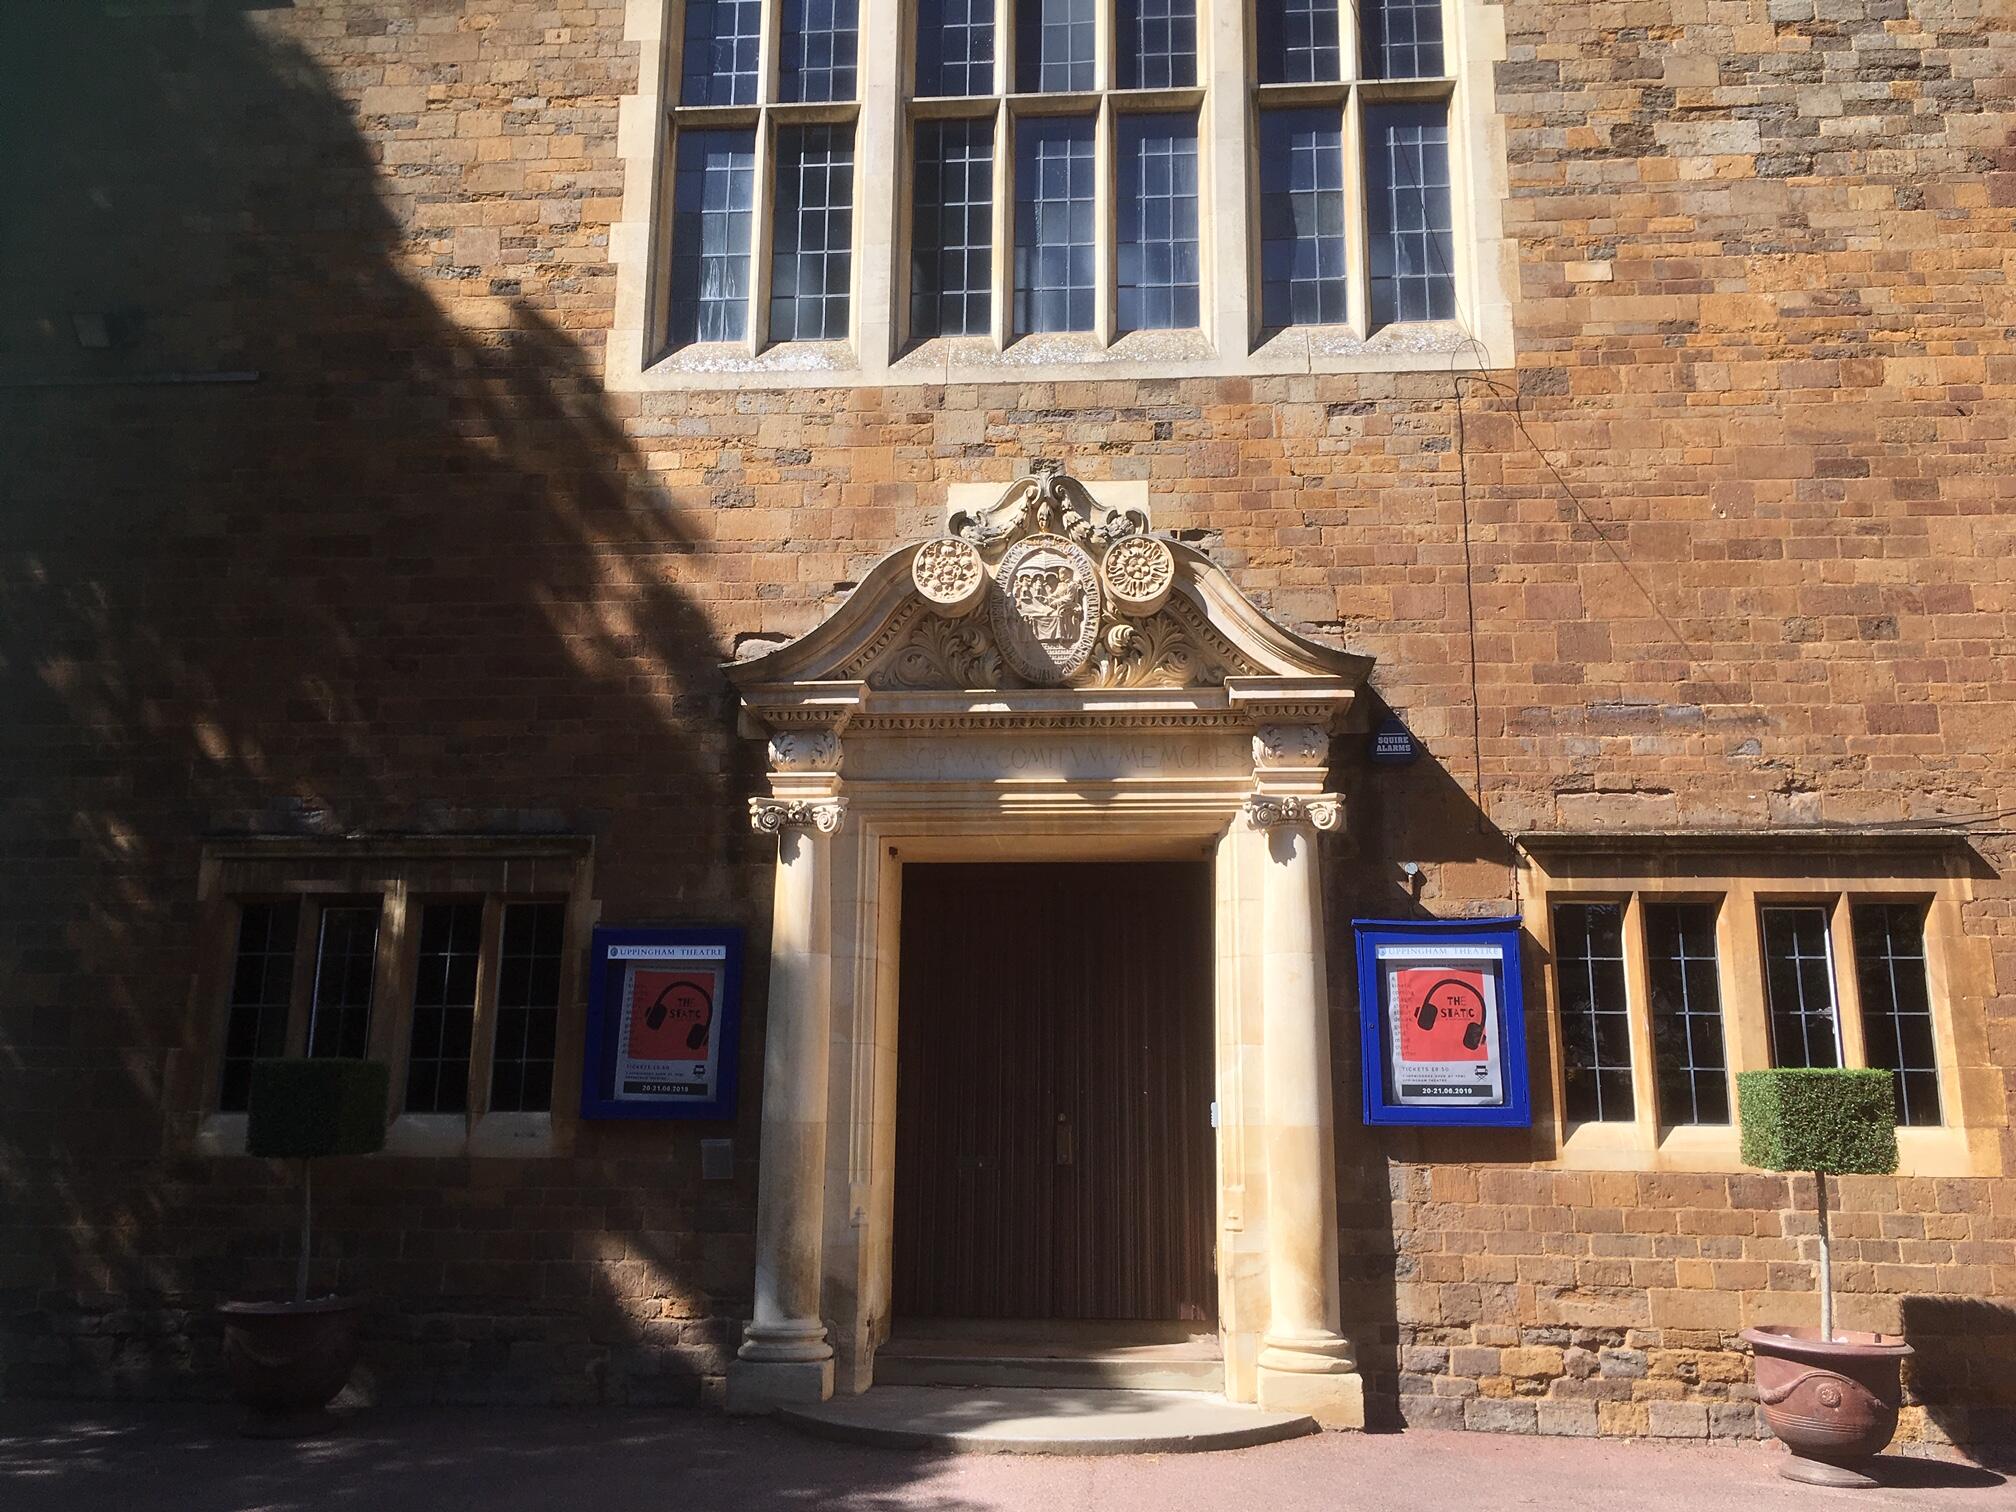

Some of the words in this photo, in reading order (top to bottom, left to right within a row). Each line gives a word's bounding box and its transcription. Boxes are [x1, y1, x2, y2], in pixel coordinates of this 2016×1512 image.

[1377, 736, 1409, 744] SQUIRE
[994, 746, 1106, 769] COMITVM
[1115, 745, 1248, 769] MEMORES
[1388, 947, 1447, 955] UPPINGHAM
[1454, 947, 1498, 955] THEATRE
[1447, 996, 1467, 1006] THE
